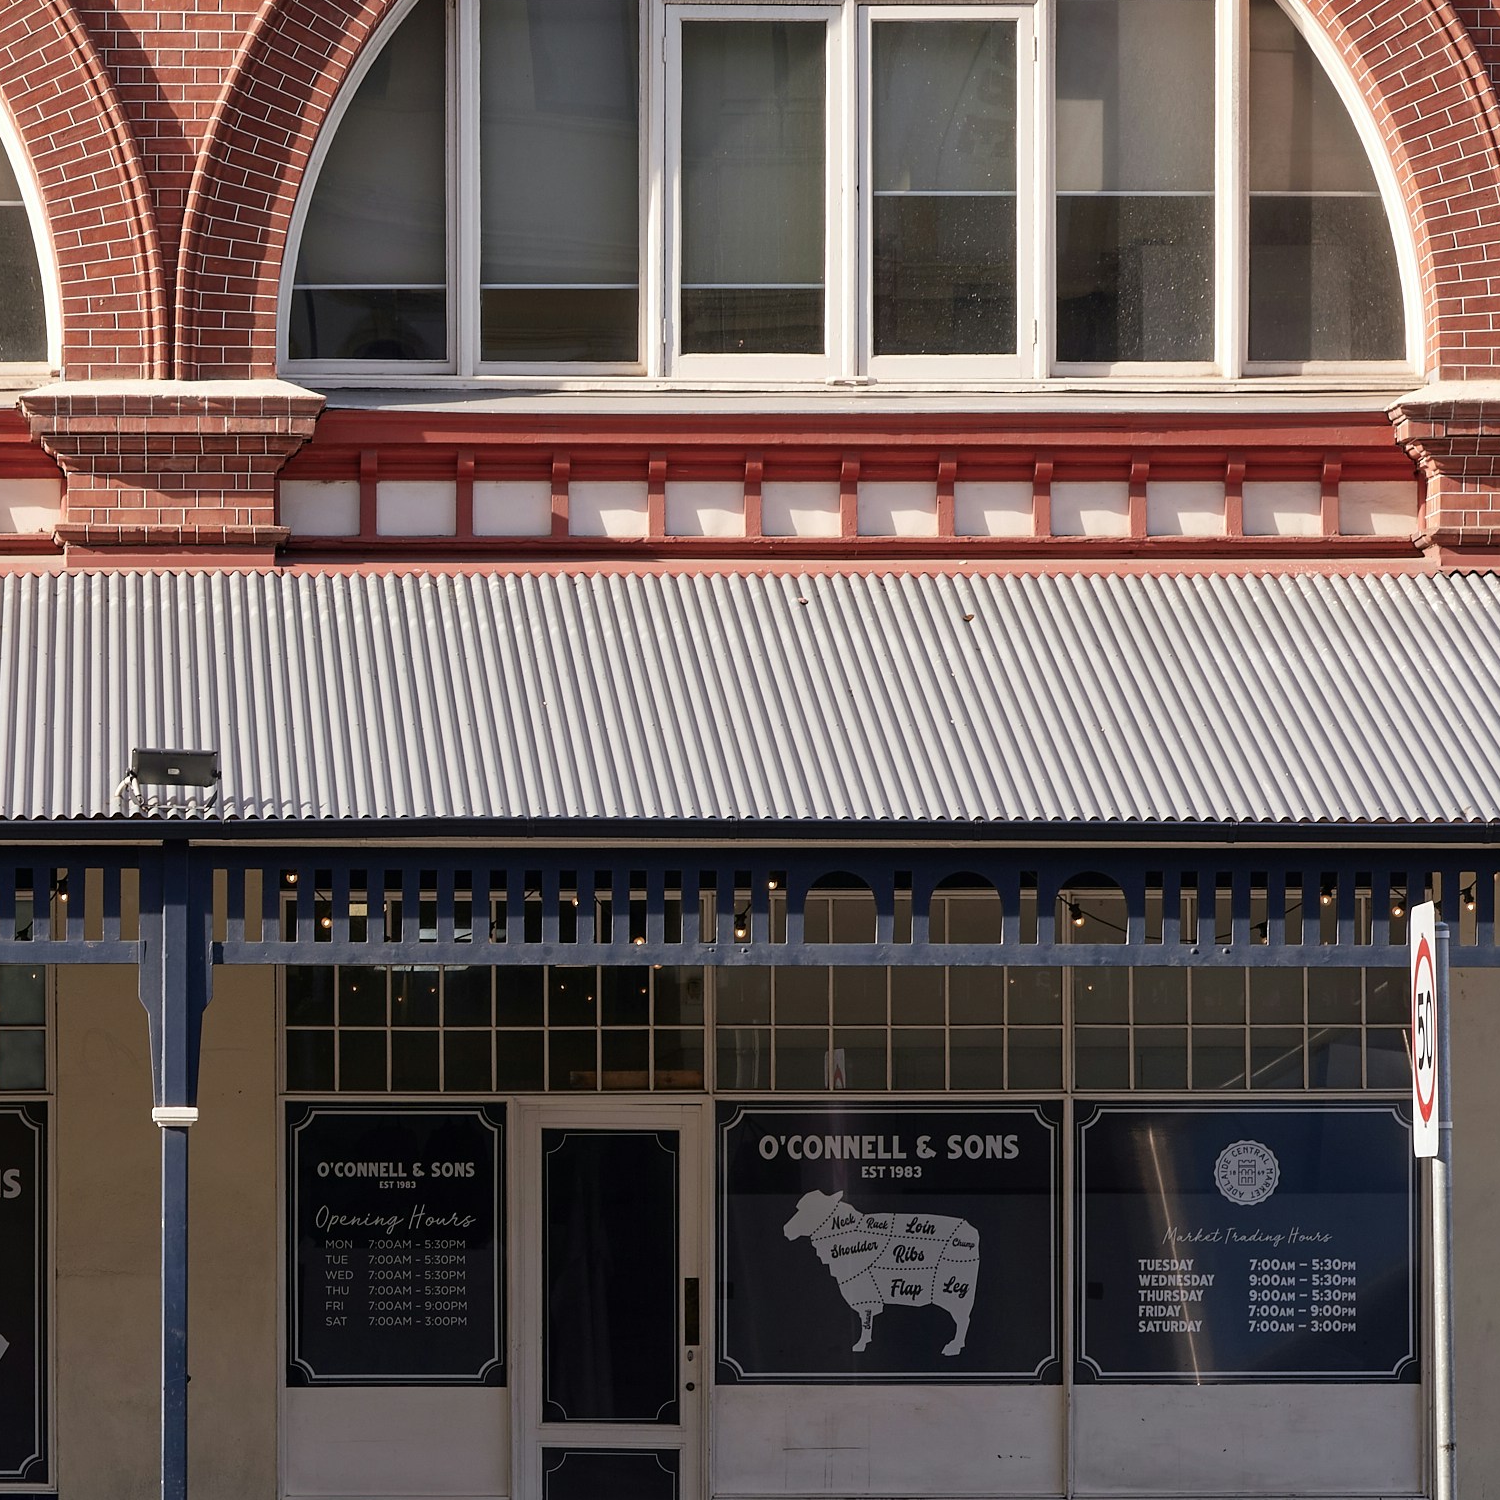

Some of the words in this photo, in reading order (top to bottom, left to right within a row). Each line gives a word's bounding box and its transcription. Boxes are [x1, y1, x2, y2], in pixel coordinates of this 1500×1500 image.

[1417, 990, 1433, 1071] 50
[759, 1135, 907, 1160] O'CONNELL
[916, 1135, 937, 1159] &
[947, 1134, 1019, 1159] SONS
[1232, 1147, 1269, 1164] CENTRAL
[317, 1162, 407, 1177] O'CONNELL
[412, 1162, 425, 1177] &
[431, 1162, 475, 1177] SONS
[861, 1166, 886, 1178] EST
[890, 1166, 922, 1178] 1983
[1221, 1158, 1244, 1198] ADELAIDE
[1251, 1168, 1273, 1198] MARKET
[379, 1181, 394, 1189] EST
[397, 1181, 416, 1189] 1983
[315, 1204, 405, 1234] Opening
[407, 1204, 477, 1229] Hours
[831, 1214, 856, 1230] Neck
[866, 1218, 888, 1230] Rack
[905, 1217, 936, 1235] Loin
[1162, 1226, 1223, 1245] Market
[1224, 1227, 1285, 1247] Trading
[1287, 1227, 1333, 1244] Hours
[326, 1240, 353, 1249] MON
[369, 1240, 411, 1249] 7:00AM
[425, 1240, 465, 1249] 5:30PM
[830, 1241, 878, 1259] Shoulder
[952, 1238, 975, 1250] Chump
[325, 1255, 348, 1264] TUE
[368, 1255, 411, 1264] 7:00AM
[425, 1255, 465, 1264] 5:30PM
[893, 1245, 924, 1263] Ribs
[1138, 1259, 1194, 1271] TUESDAY
[1249, 1259, 1295, 1271] 7:00AM
[1312, 1259, 1356, 1270] 5:30PM
[325, 1270, 354, 1280] WED
[368, 1270, 411, 1280] 7:00AM
[425, 1270, 465, 1280] 5:30PM
[1138, 1274, 1215, 1286] WEDNESDAY
[1249, 1274, 1295, 1286] 9:00AM
[1312, 1274, 1356, 1286] 5:30PM
[326, 1286, 349, 1295] THU
[369, 1286, 412, 1295] 7:00AM
[425, 1286, 466, 1295] 5:30PM
[891, 1278, 923, 1300] Flap
[943, 1276, 969, 1298] Leg
[1138, 1290, 1204, 1302] THURSDAY
[1249, 1290, 1295, 1301] 9:00AM
[1312, 1289, 1356, 1301] 5:30PM
[326, 1301, 343, 1310] FRI
[368, 1301, 412, 1310] 7:00AM
[425, 1301, 467, 1310] 9:00PM
[1138, 1305, 1181, 1317] FRIDAY
[1248, 1305, 1294, 1317] 7:00AM
[1310, 1305, 1356, 1316] 9:00PM
[326, 1317, 347, 1326] SAT
[369, 1316, 412, 1326] 7:00AM
[425, 1316, 467, 1326] 3:00PM
[1138, 1321, 1203, 1332] SATURDAY
[1248, 1320, 1294, 1332] 7:00AM
[1311, 1320, 1356, 1332] 3:00PM
